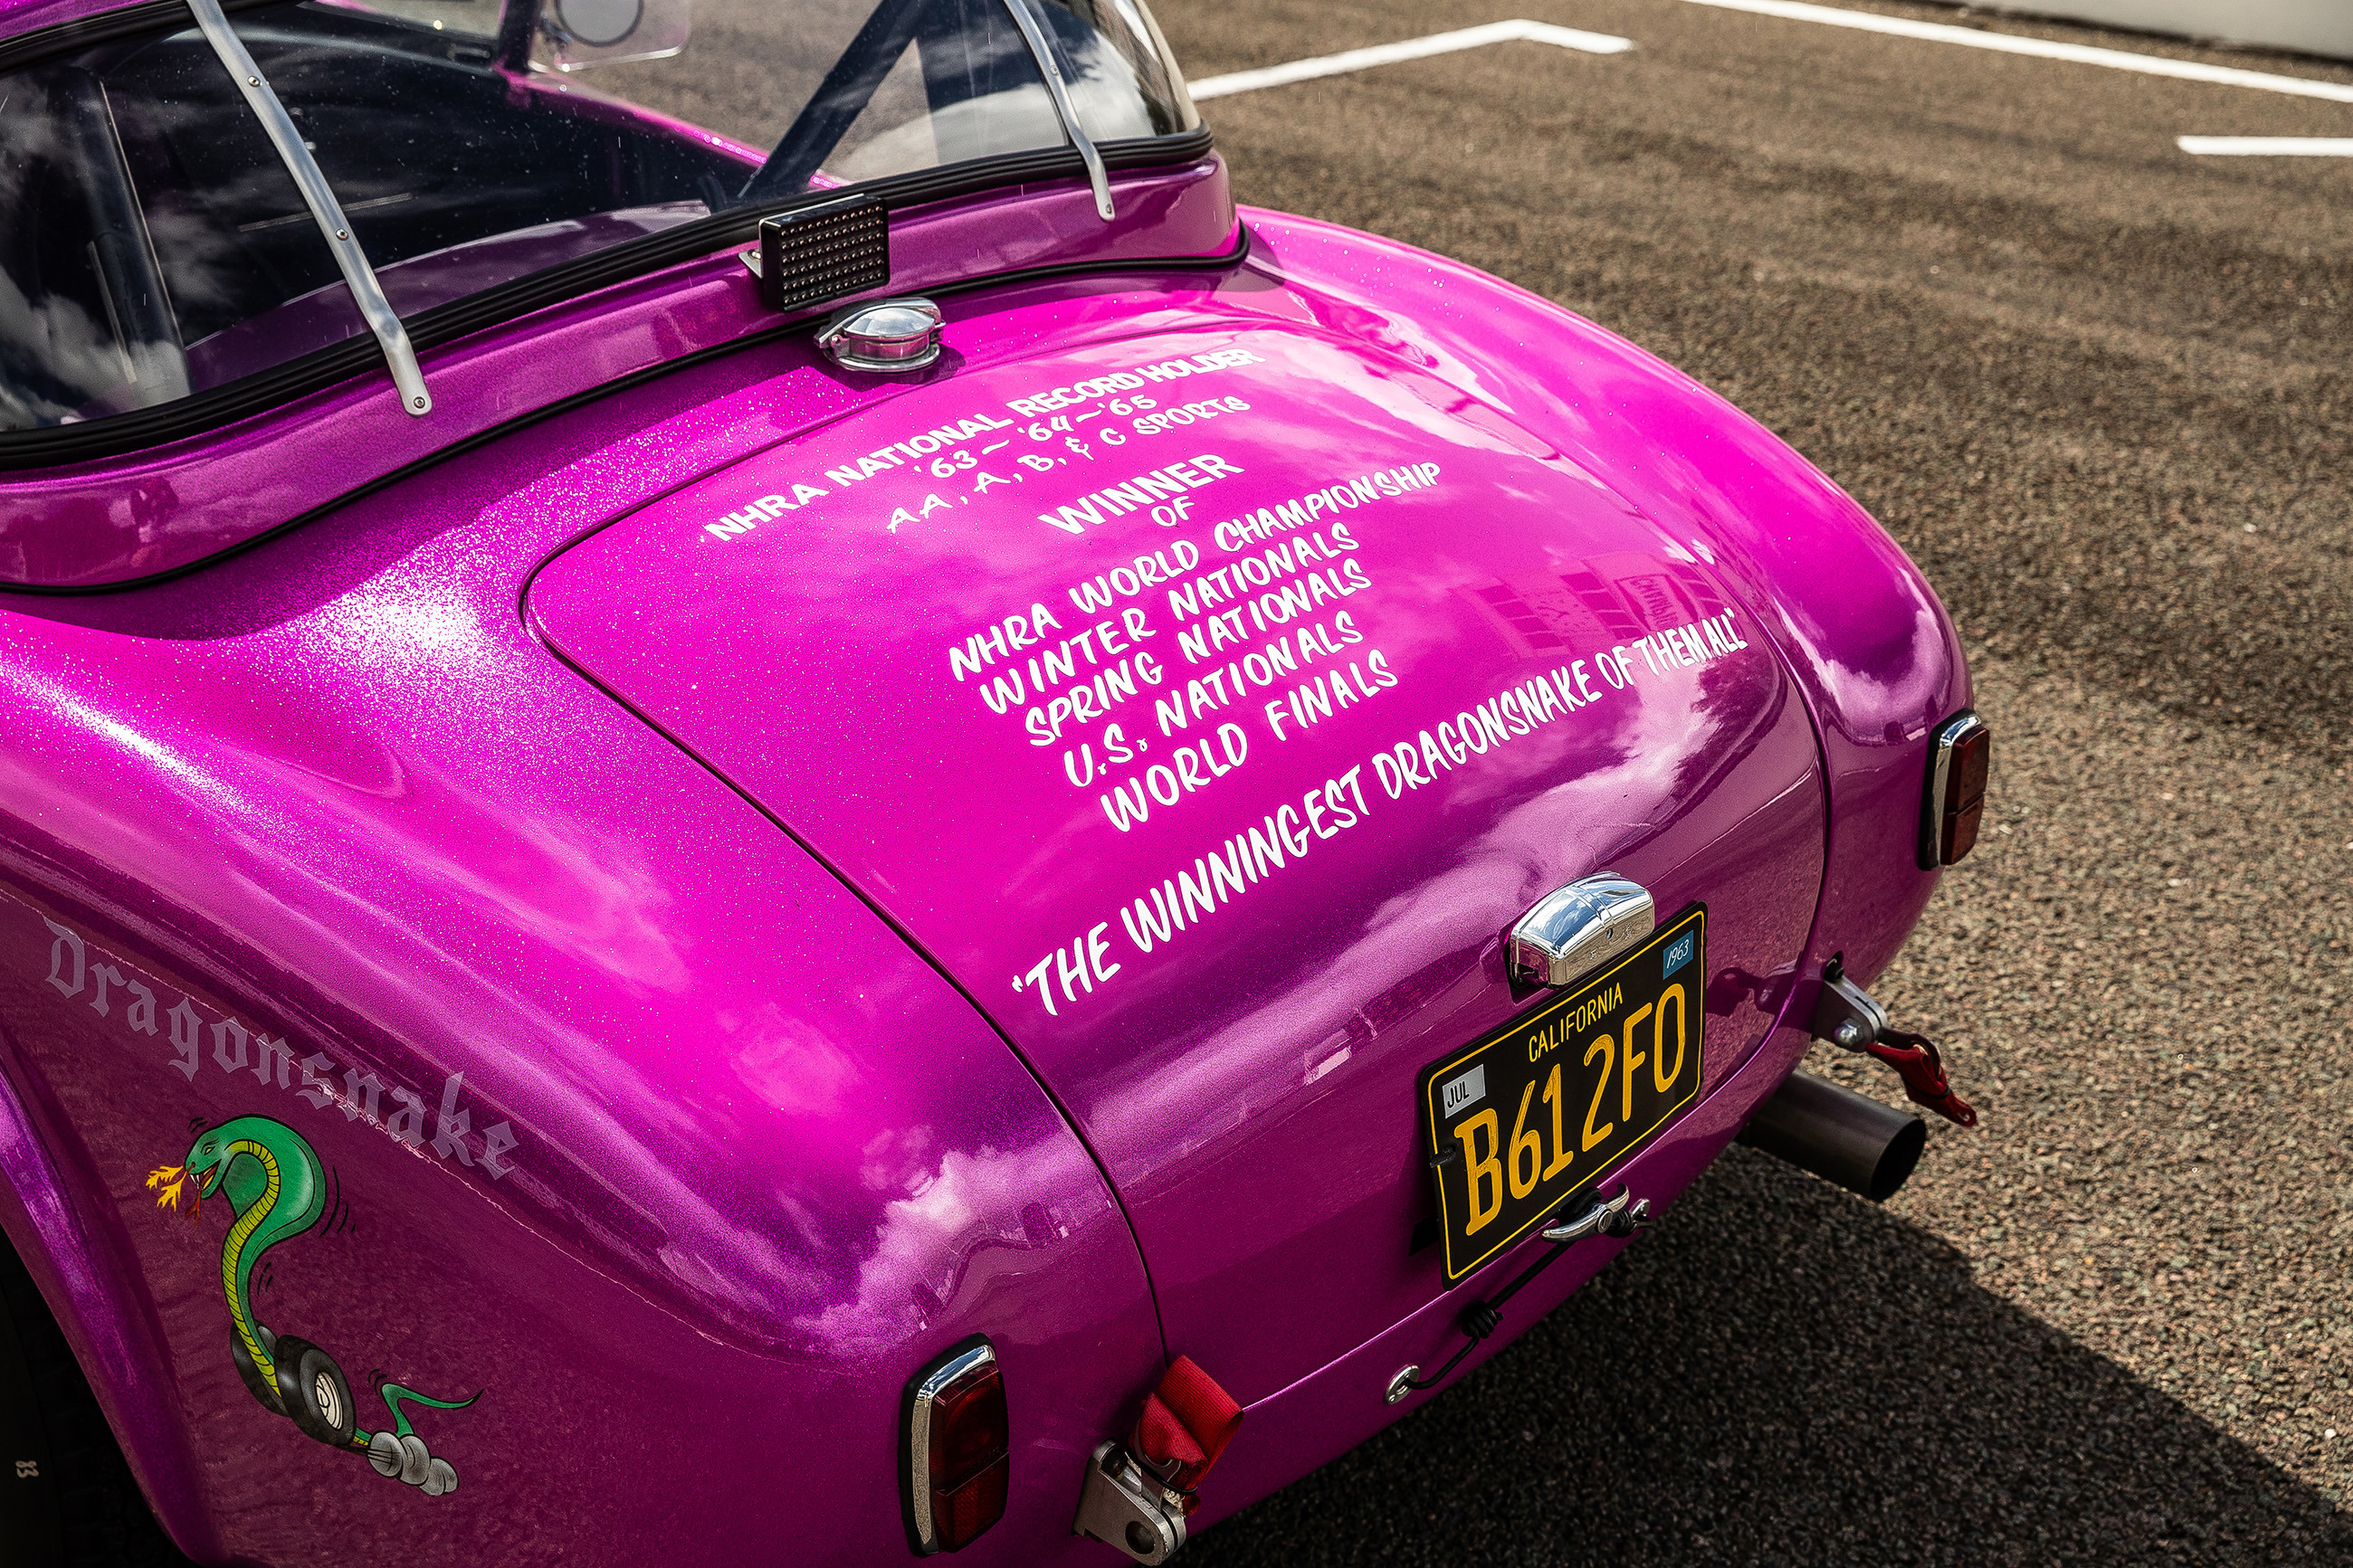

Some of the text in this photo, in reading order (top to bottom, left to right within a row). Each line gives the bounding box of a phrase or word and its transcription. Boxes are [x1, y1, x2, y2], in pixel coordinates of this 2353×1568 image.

[702, 348, 1266, 542] NHRA NATIONAL RECORD HOLDER
[1037, 454, 1245, 535] WINNER
[1064, 436, 1094, 461] &
[1099, 427, 1127, 445] C
[1132, 395, 1252, 435] SPORTS
[948, 461, 1441, 682] NHRA WORLD CHAMPIONSHIP
[1150, 495, 1196, 527] OF
[979, 522, 1359, 715] WINTER NATIONALS
[1024, 557, 1372, 746] SPRING NATIONALS
[1155, 610, 1364, 737] NATIONALS
[1100, 649, 1398, 832] WORLD FINALS
[1119, 764, 1370, 954] WINNINGEST
[1371, 659, 1603, 800] DRAGONSNAKE
[1595, 645, 1634, 690] OF
[1528, 982, 1624, 1064] CALIFORNIA
[1665, 937, 1691, 970] 1963
[41, 916, 520, 1181] Dragonsnake
[1446, 1081, 1470, 1109] JUL
